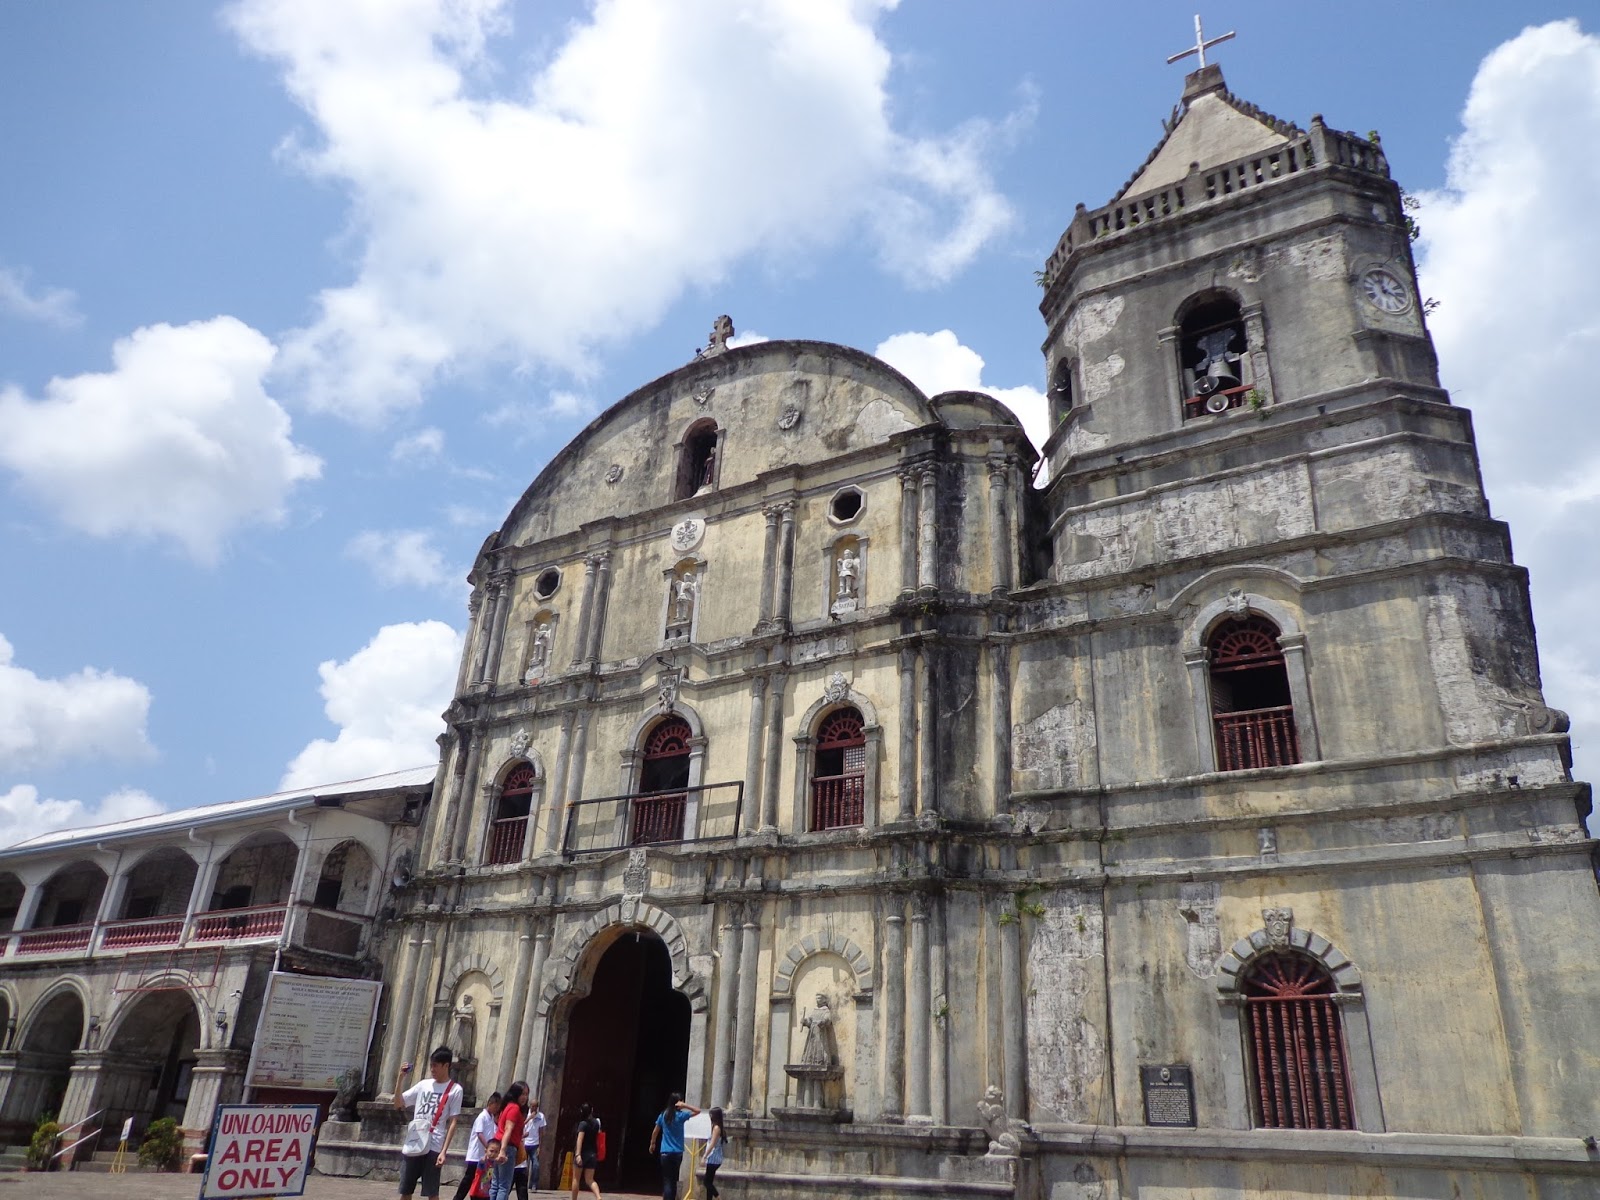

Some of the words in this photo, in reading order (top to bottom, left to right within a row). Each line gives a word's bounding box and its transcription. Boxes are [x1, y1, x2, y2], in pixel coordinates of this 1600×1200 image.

[221, 1113, 313, 1135] UNLOADING
[218, 1138, 302, 1165] AREA
[217, 1166, 299, 1191] ONLY
